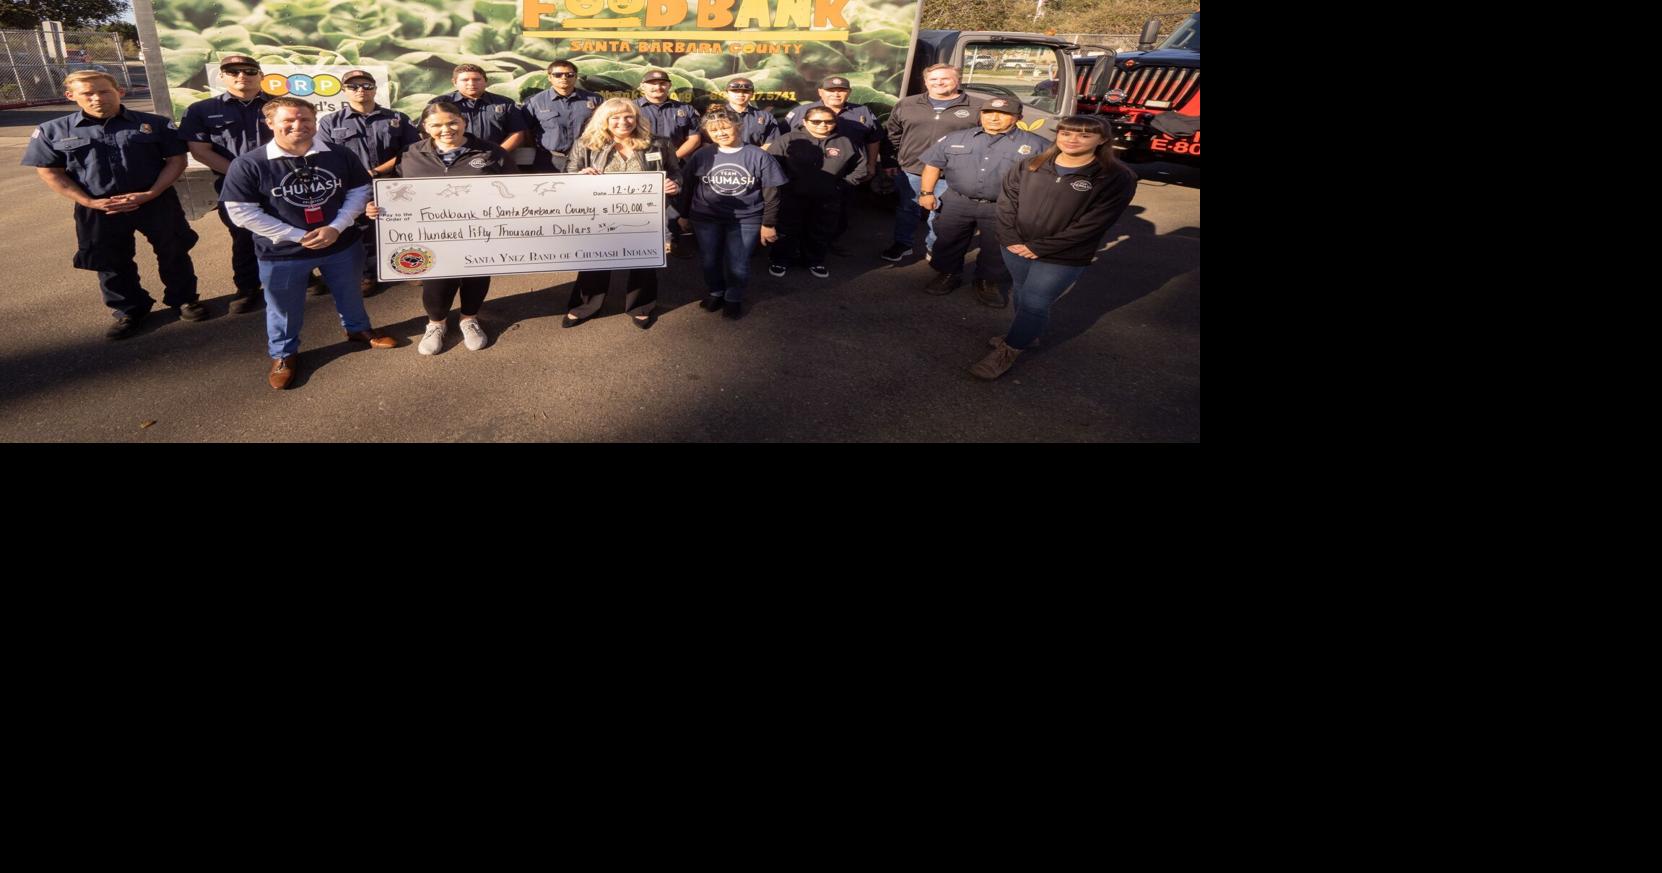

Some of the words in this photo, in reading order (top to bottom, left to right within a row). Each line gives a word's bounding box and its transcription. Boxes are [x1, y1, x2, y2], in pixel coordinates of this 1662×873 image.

[569, 40, 631, 53] SANTA
[638, 41, 723, 54] BARBARA
[729, 43, 803, 55] COUNTY
[269, 79, 333, 91] PRP
[702, 175, 755, 186] CHUMASH
[271, 178, 342, 198] CHUMASH
[482, 208, 493, 218] of
[495, 205, 520, 217] Santa
[611, 202, 643, 215] 150,000
[388, 229, 414, 243] One
[418, 226, 464, 240] Hundred
[495, 223, 544, 237] Thousand
[552, 223, 591, 235] Dollars
